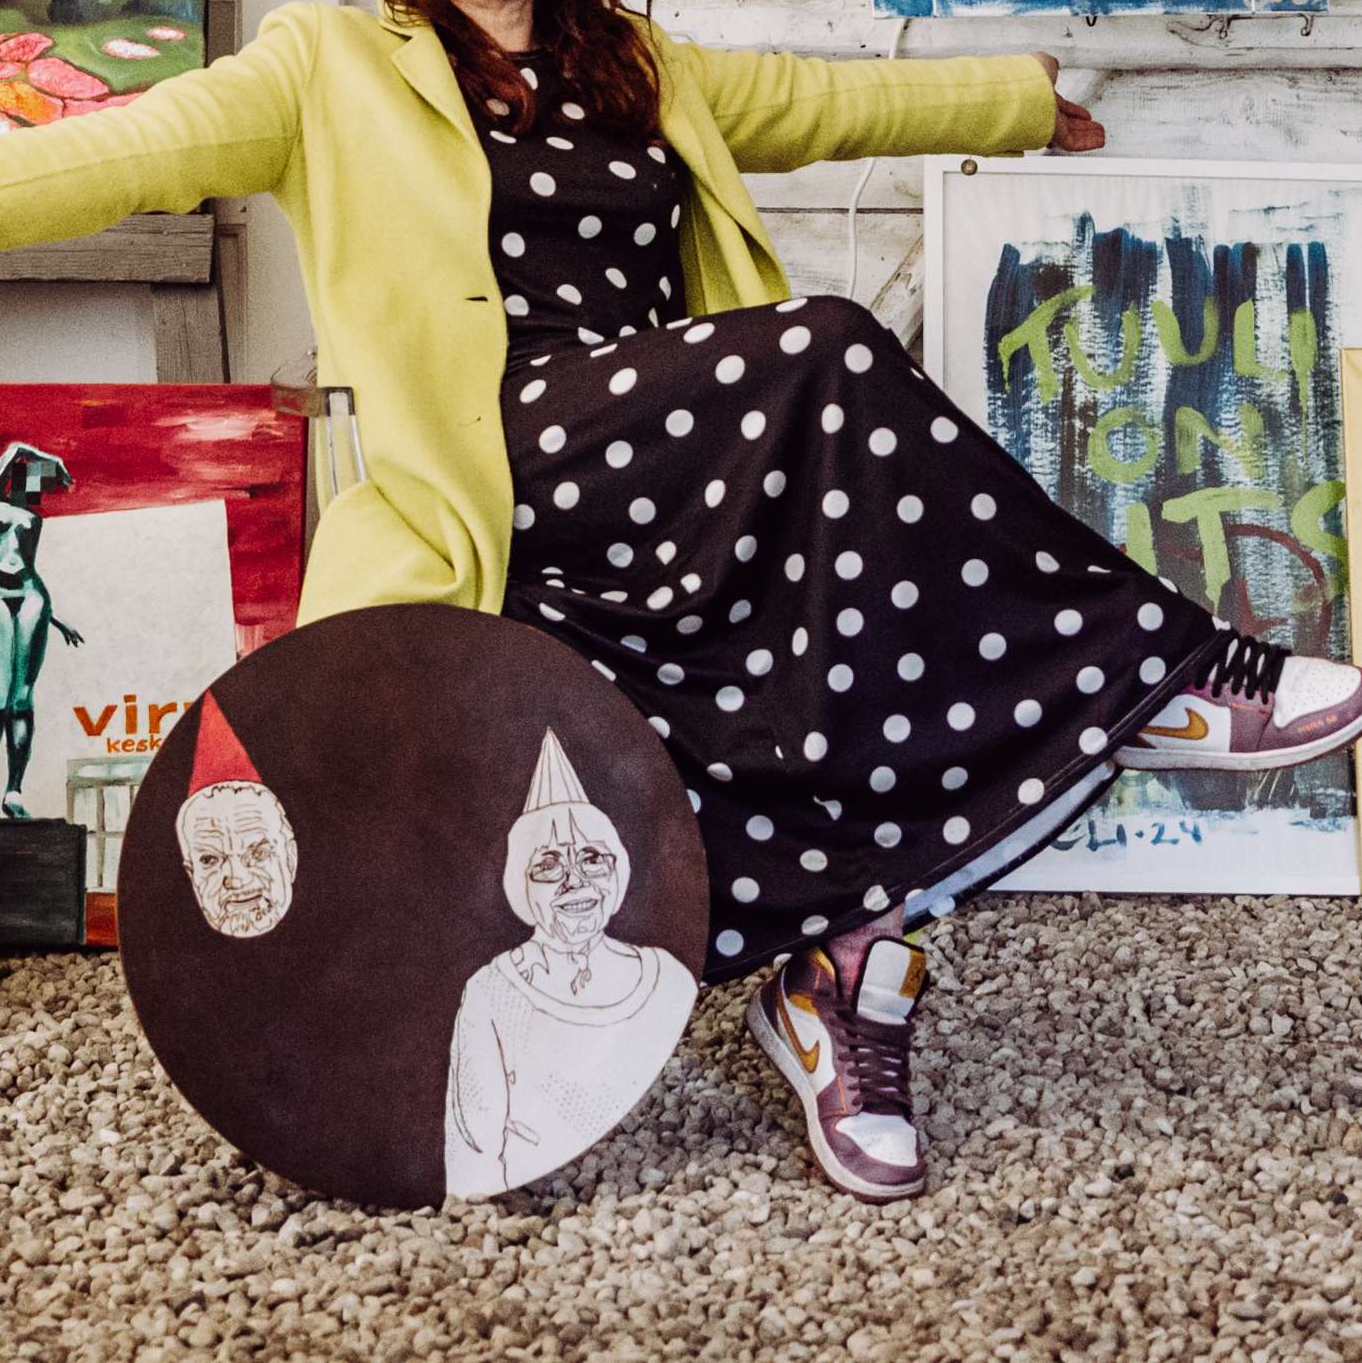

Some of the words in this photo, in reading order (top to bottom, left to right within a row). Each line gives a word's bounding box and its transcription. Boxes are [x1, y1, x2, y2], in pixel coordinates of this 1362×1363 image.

[997, 284, 1318, 405] TUULI
[1087, 402, 1265, 485] ON
[73, 694, 196, 737] vir
